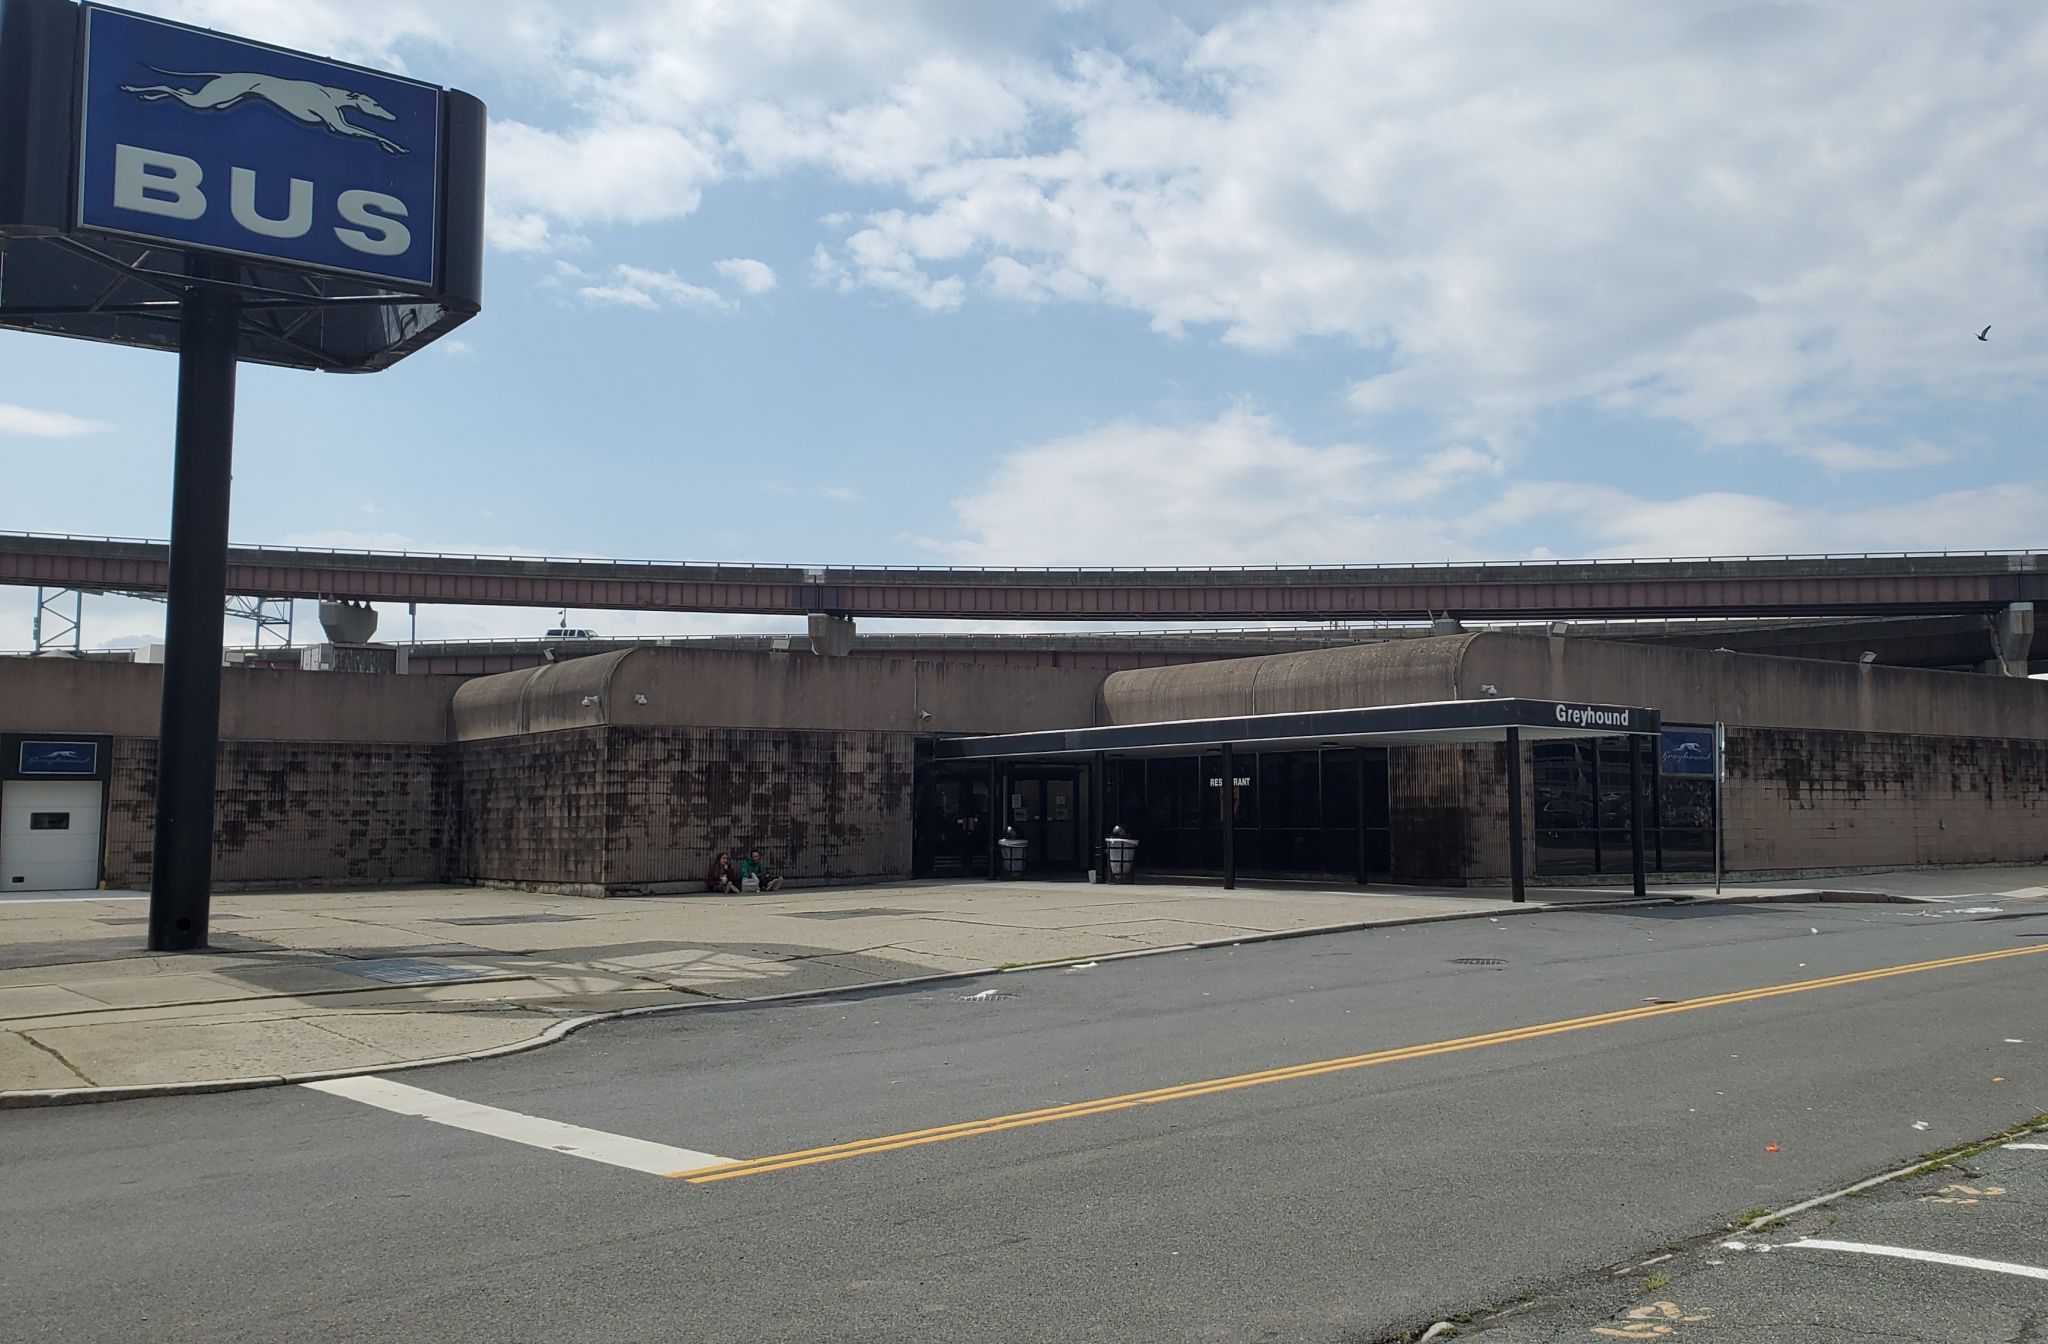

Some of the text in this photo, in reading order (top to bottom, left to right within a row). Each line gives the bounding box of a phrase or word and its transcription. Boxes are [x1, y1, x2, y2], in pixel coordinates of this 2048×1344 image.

[113, 143, 411, 257] BUS
[1555, 704, 1629, 726] Greyhound
[1210, 777, 1251, 787] RESRANT
